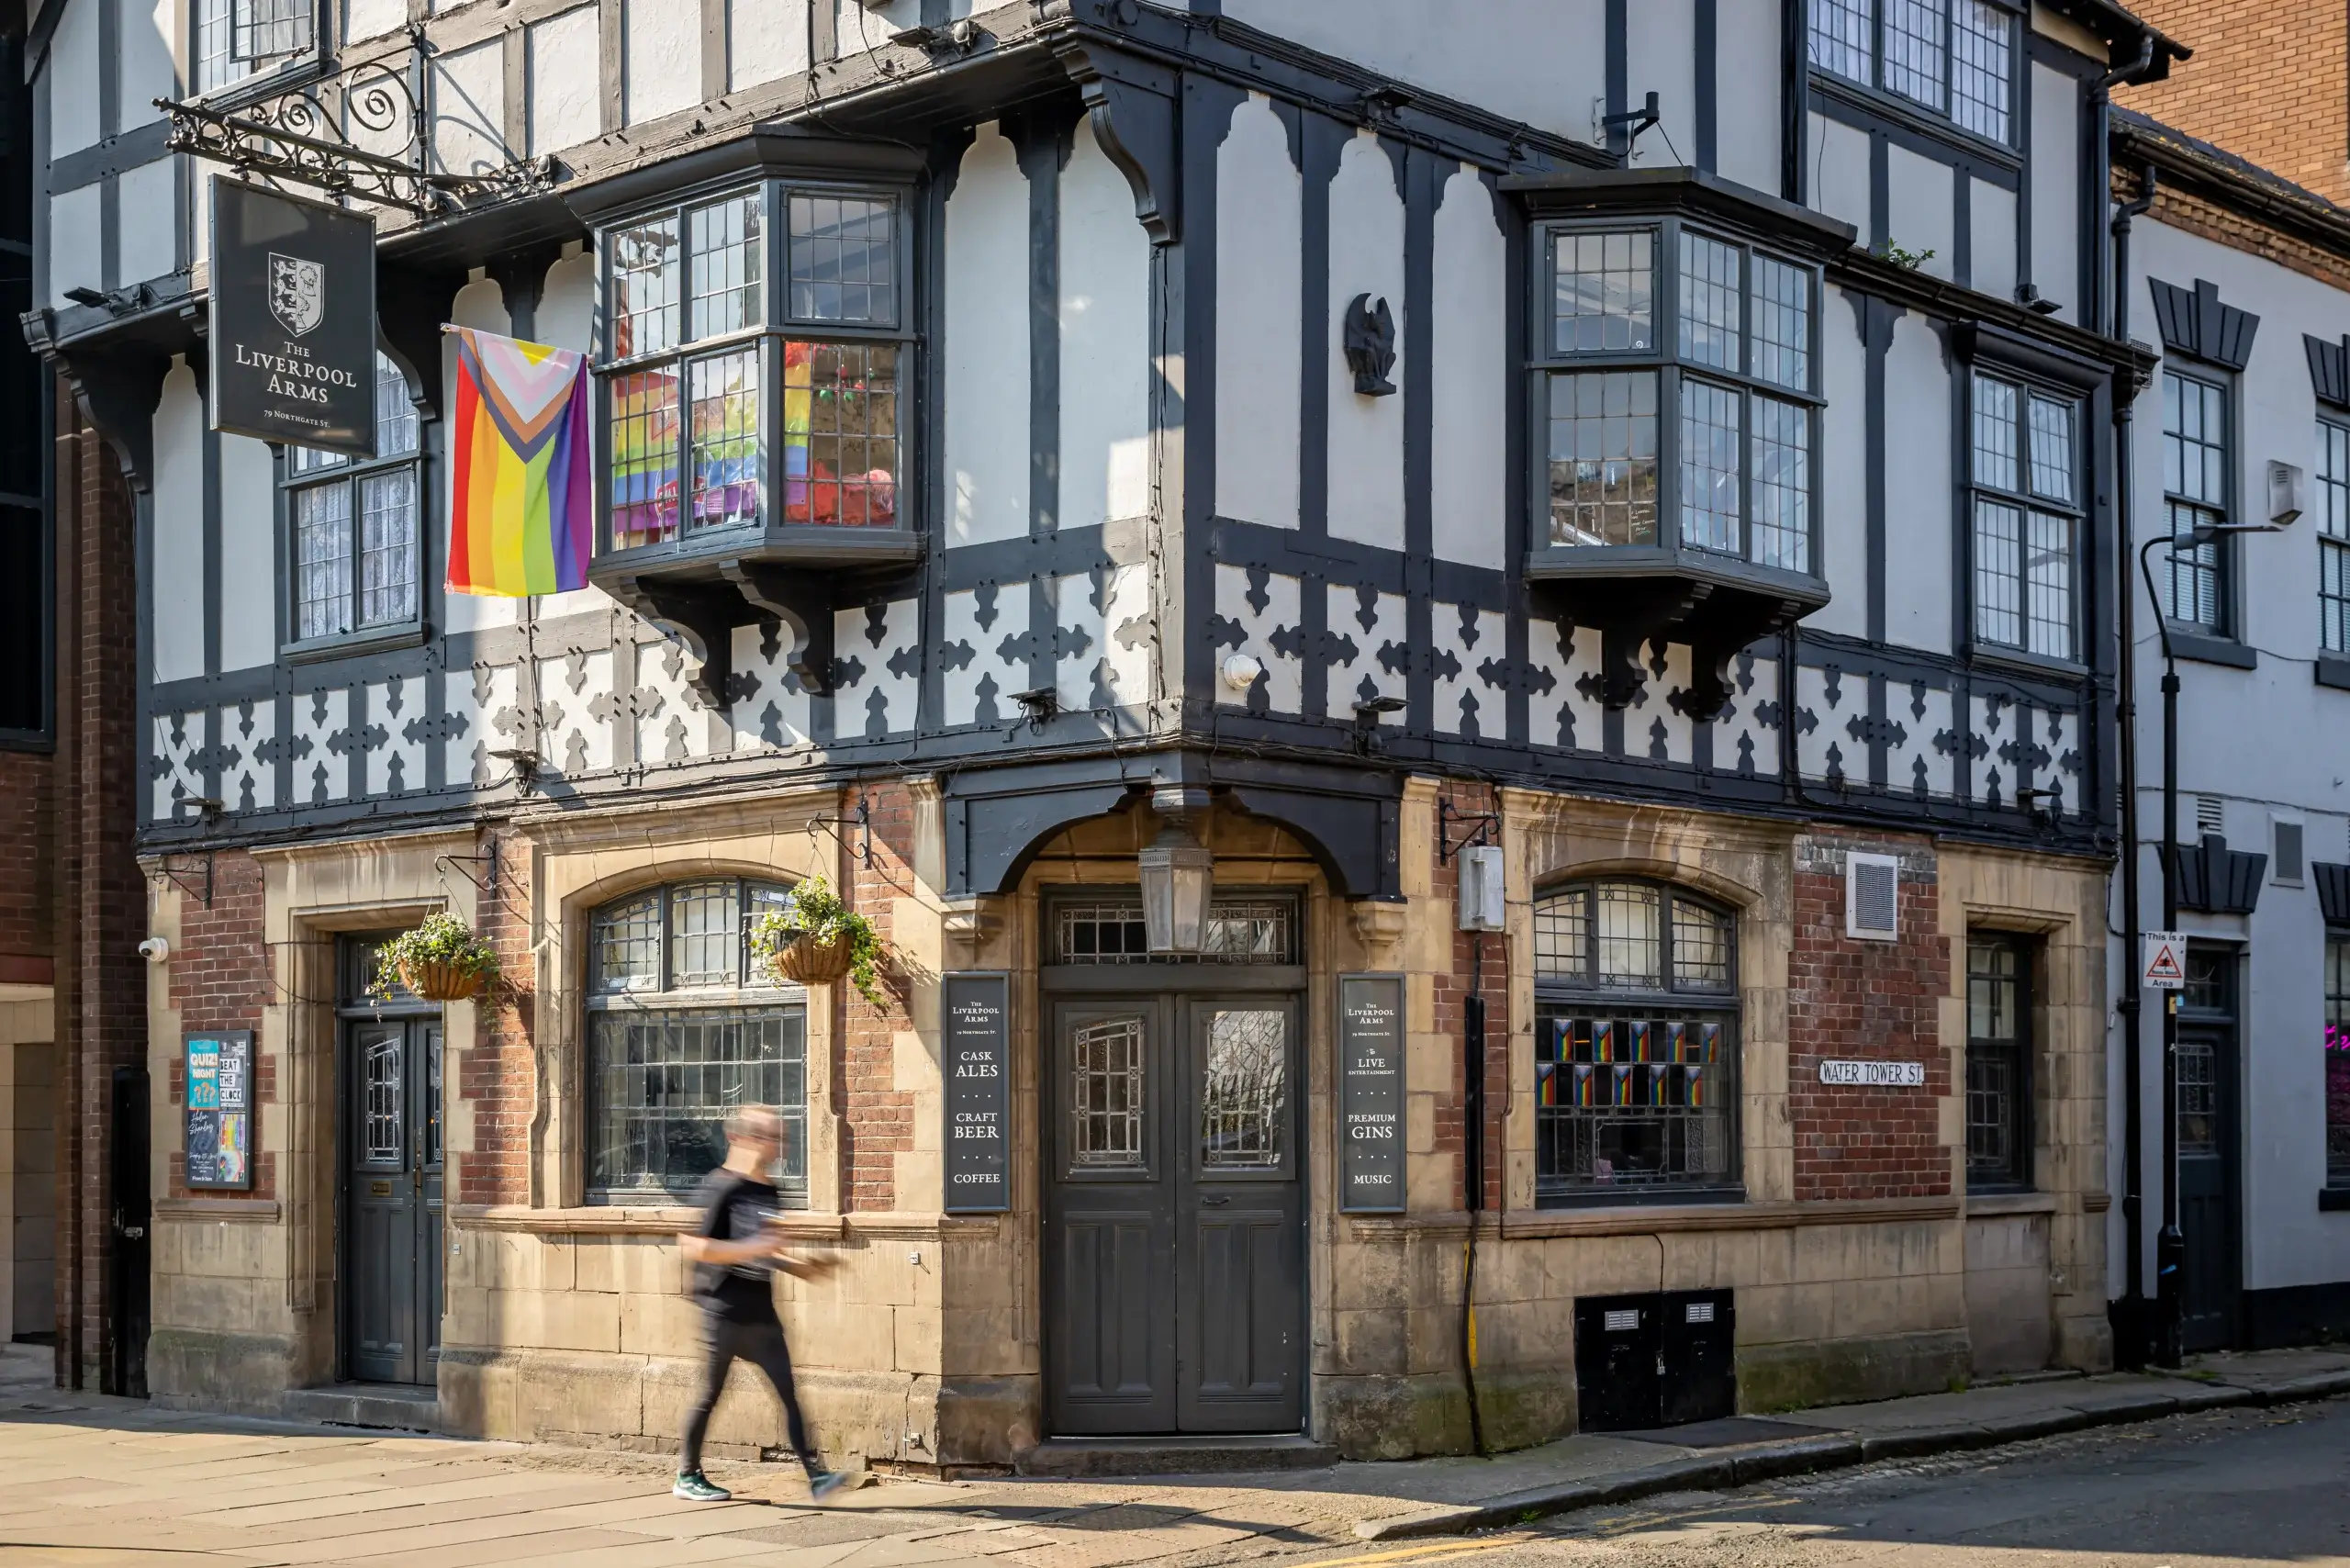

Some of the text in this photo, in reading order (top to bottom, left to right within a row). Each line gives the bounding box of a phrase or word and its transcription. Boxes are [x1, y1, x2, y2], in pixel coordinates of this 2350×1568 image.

[285, 342, 310, 357] THE
[235, 343, 357, 388] LIVERPOOL
[267, 374, 328, 403] ARMS
[274, 410, 319, 426] NORTHGATE
[2147, 933, 2166, 941] This
[2169, 932, 2177, 941] is
[2152, 980, 2174, 988] Area
[191, 1053, 218, 1067] QUIZ!
[960, 1051, 993, 1061] CASK
[220, 1060, 237, 1070] BEAT
[1358, 1058, 1386, 1068] LIVE
[193, 1069, 216, 1080] NIGHT
[956, 1065, 999, 1078] ALES
[1823, 1063, 1859, 1082] WATER
[1864, 1064, 1902, 1082] TOWER
[220, 1075, 233, 1085] THE
[220, 1090, 241, 1100] CLOCK
[956, 1113, 998, 1122] CRAFT
[1348, 1114, 1396, 1123] PREMIUM
[955, 1126, 1000, 1138] BEER
[1352, 1126, 1393, 1138] GINS
[954, 1173, 1001, 1183] COFFEE
[1354, 1174, 1393, 1184] MUSIC
